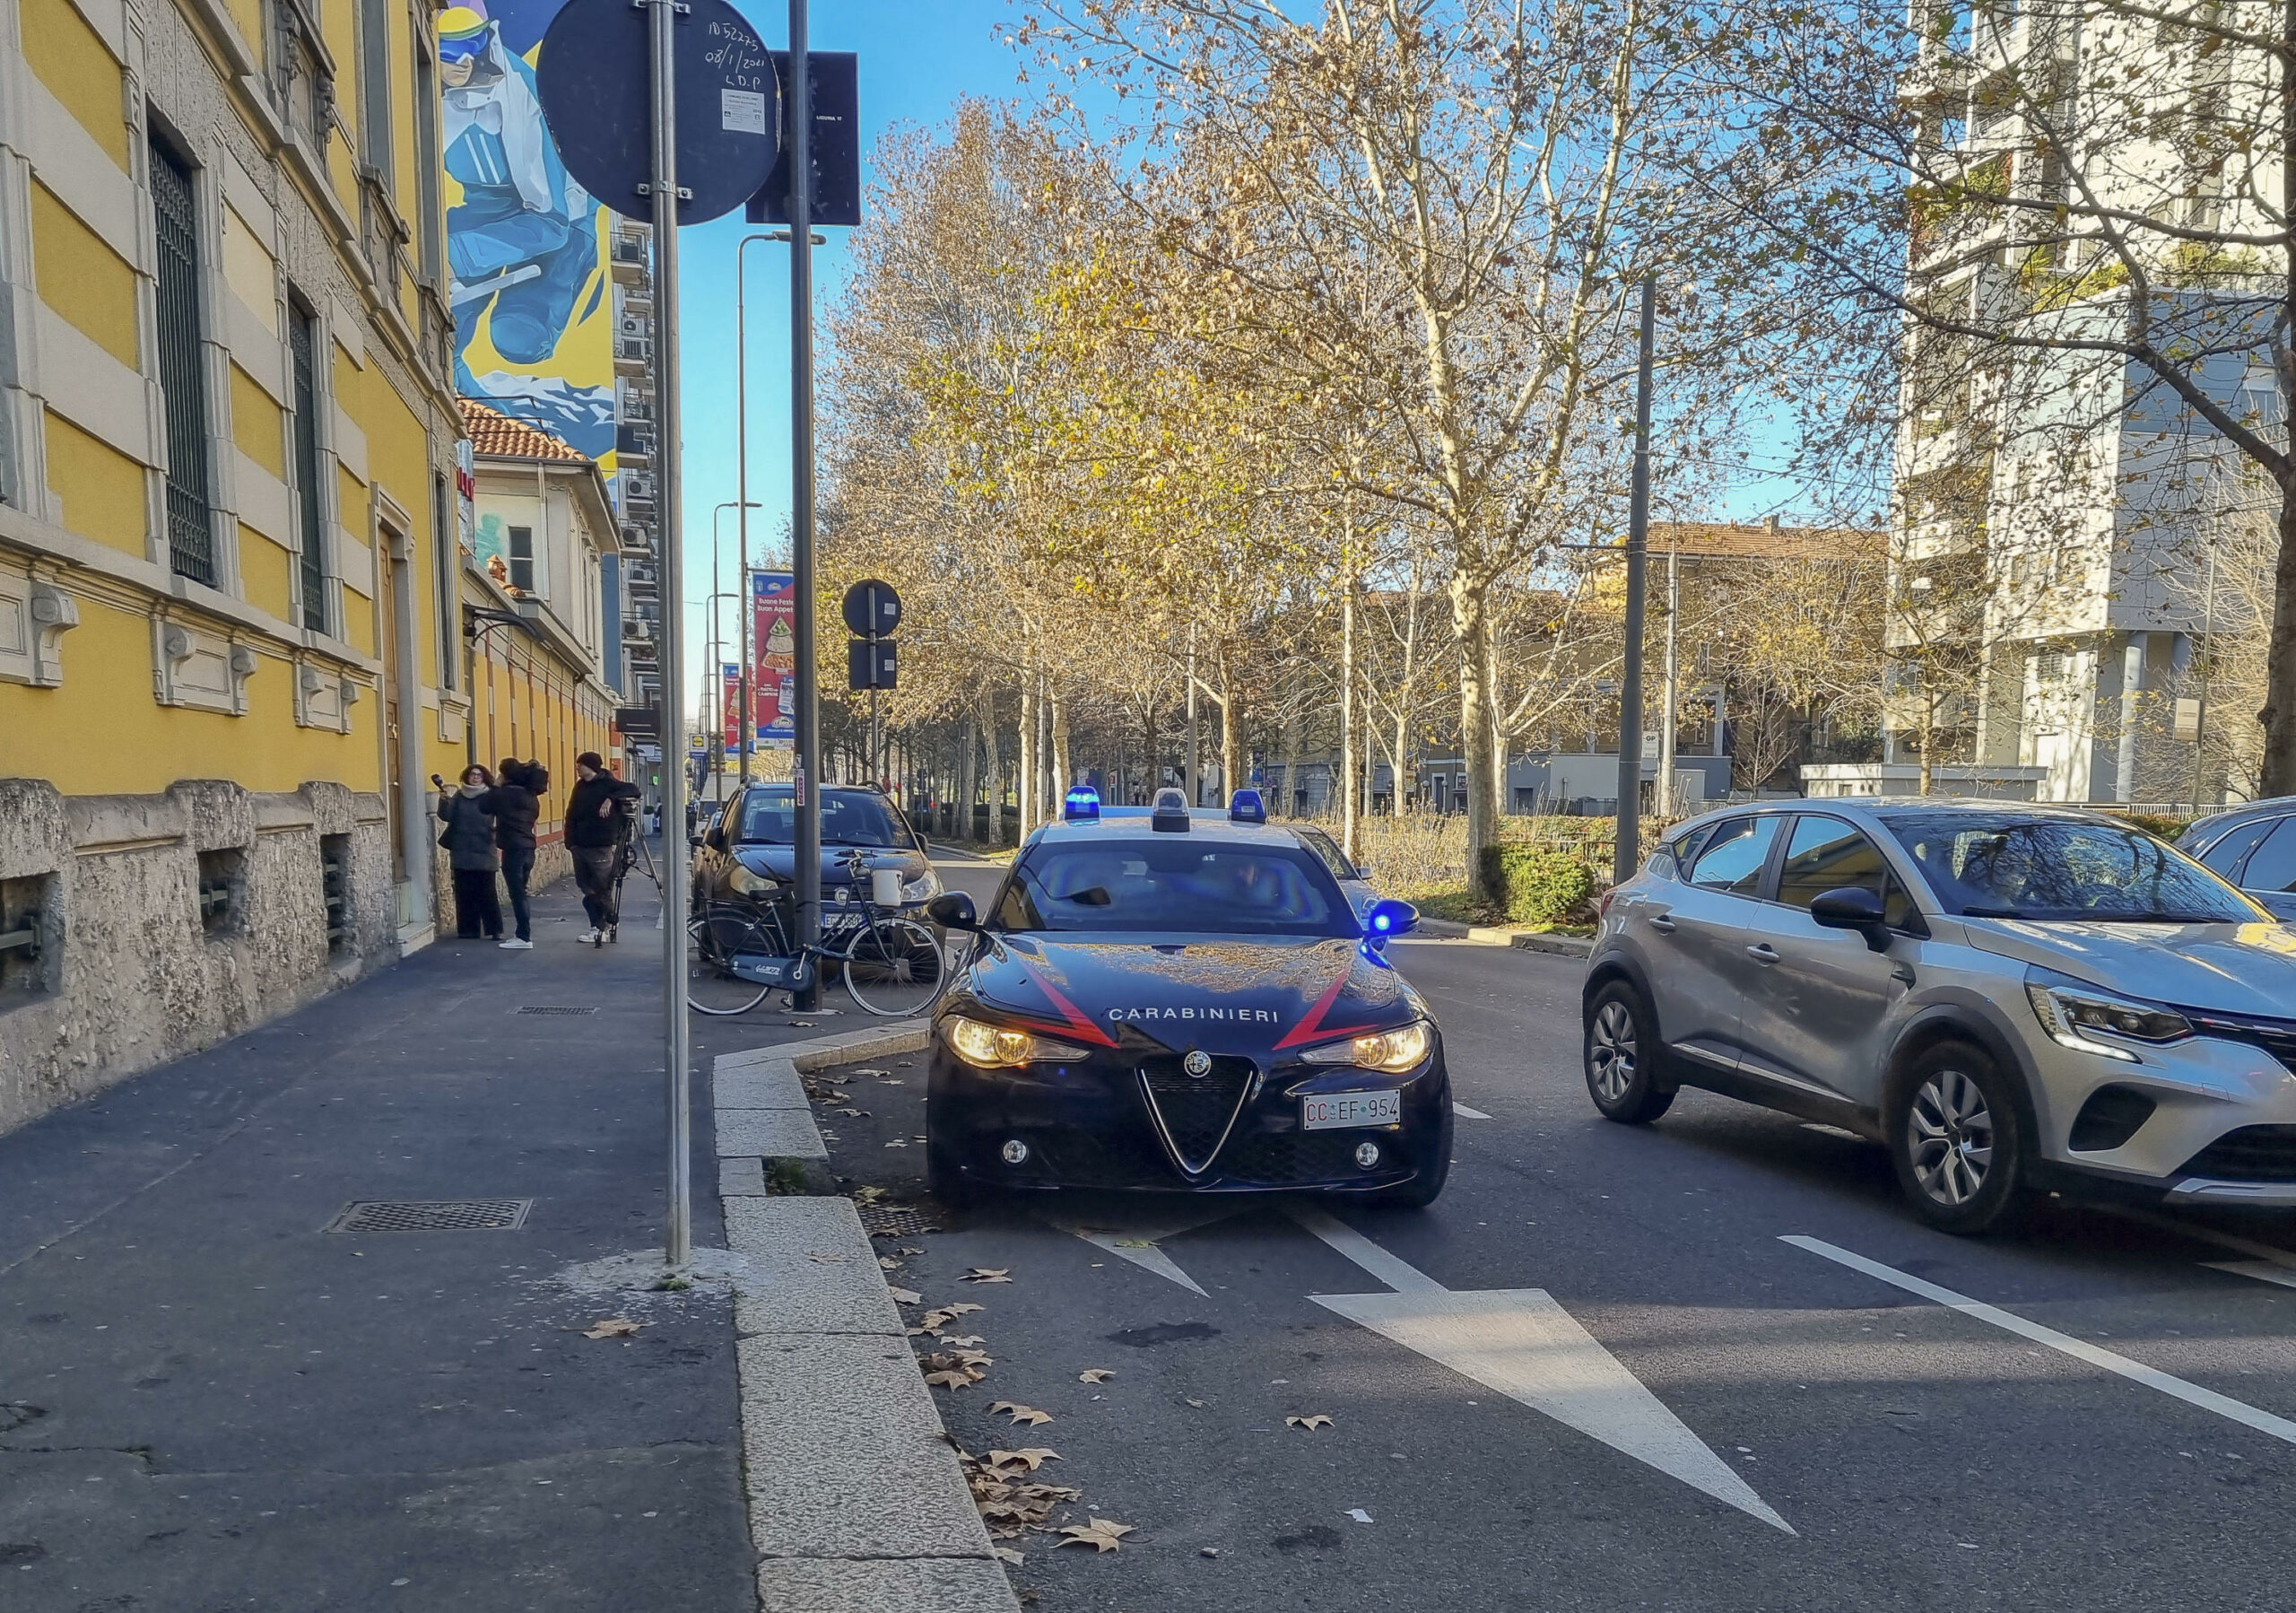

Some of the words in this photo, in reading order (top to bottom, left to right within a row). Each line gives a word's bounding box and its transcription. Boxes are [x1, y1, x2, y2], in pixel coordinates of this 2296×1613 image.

[1109, 1007, 1278, 1023] CARABINIERI
[1306, 1103, 1327, 1121] CC
[1339, 1101, 1359, 1120] EF
[1369, 1097, 1397, 1118] 954
